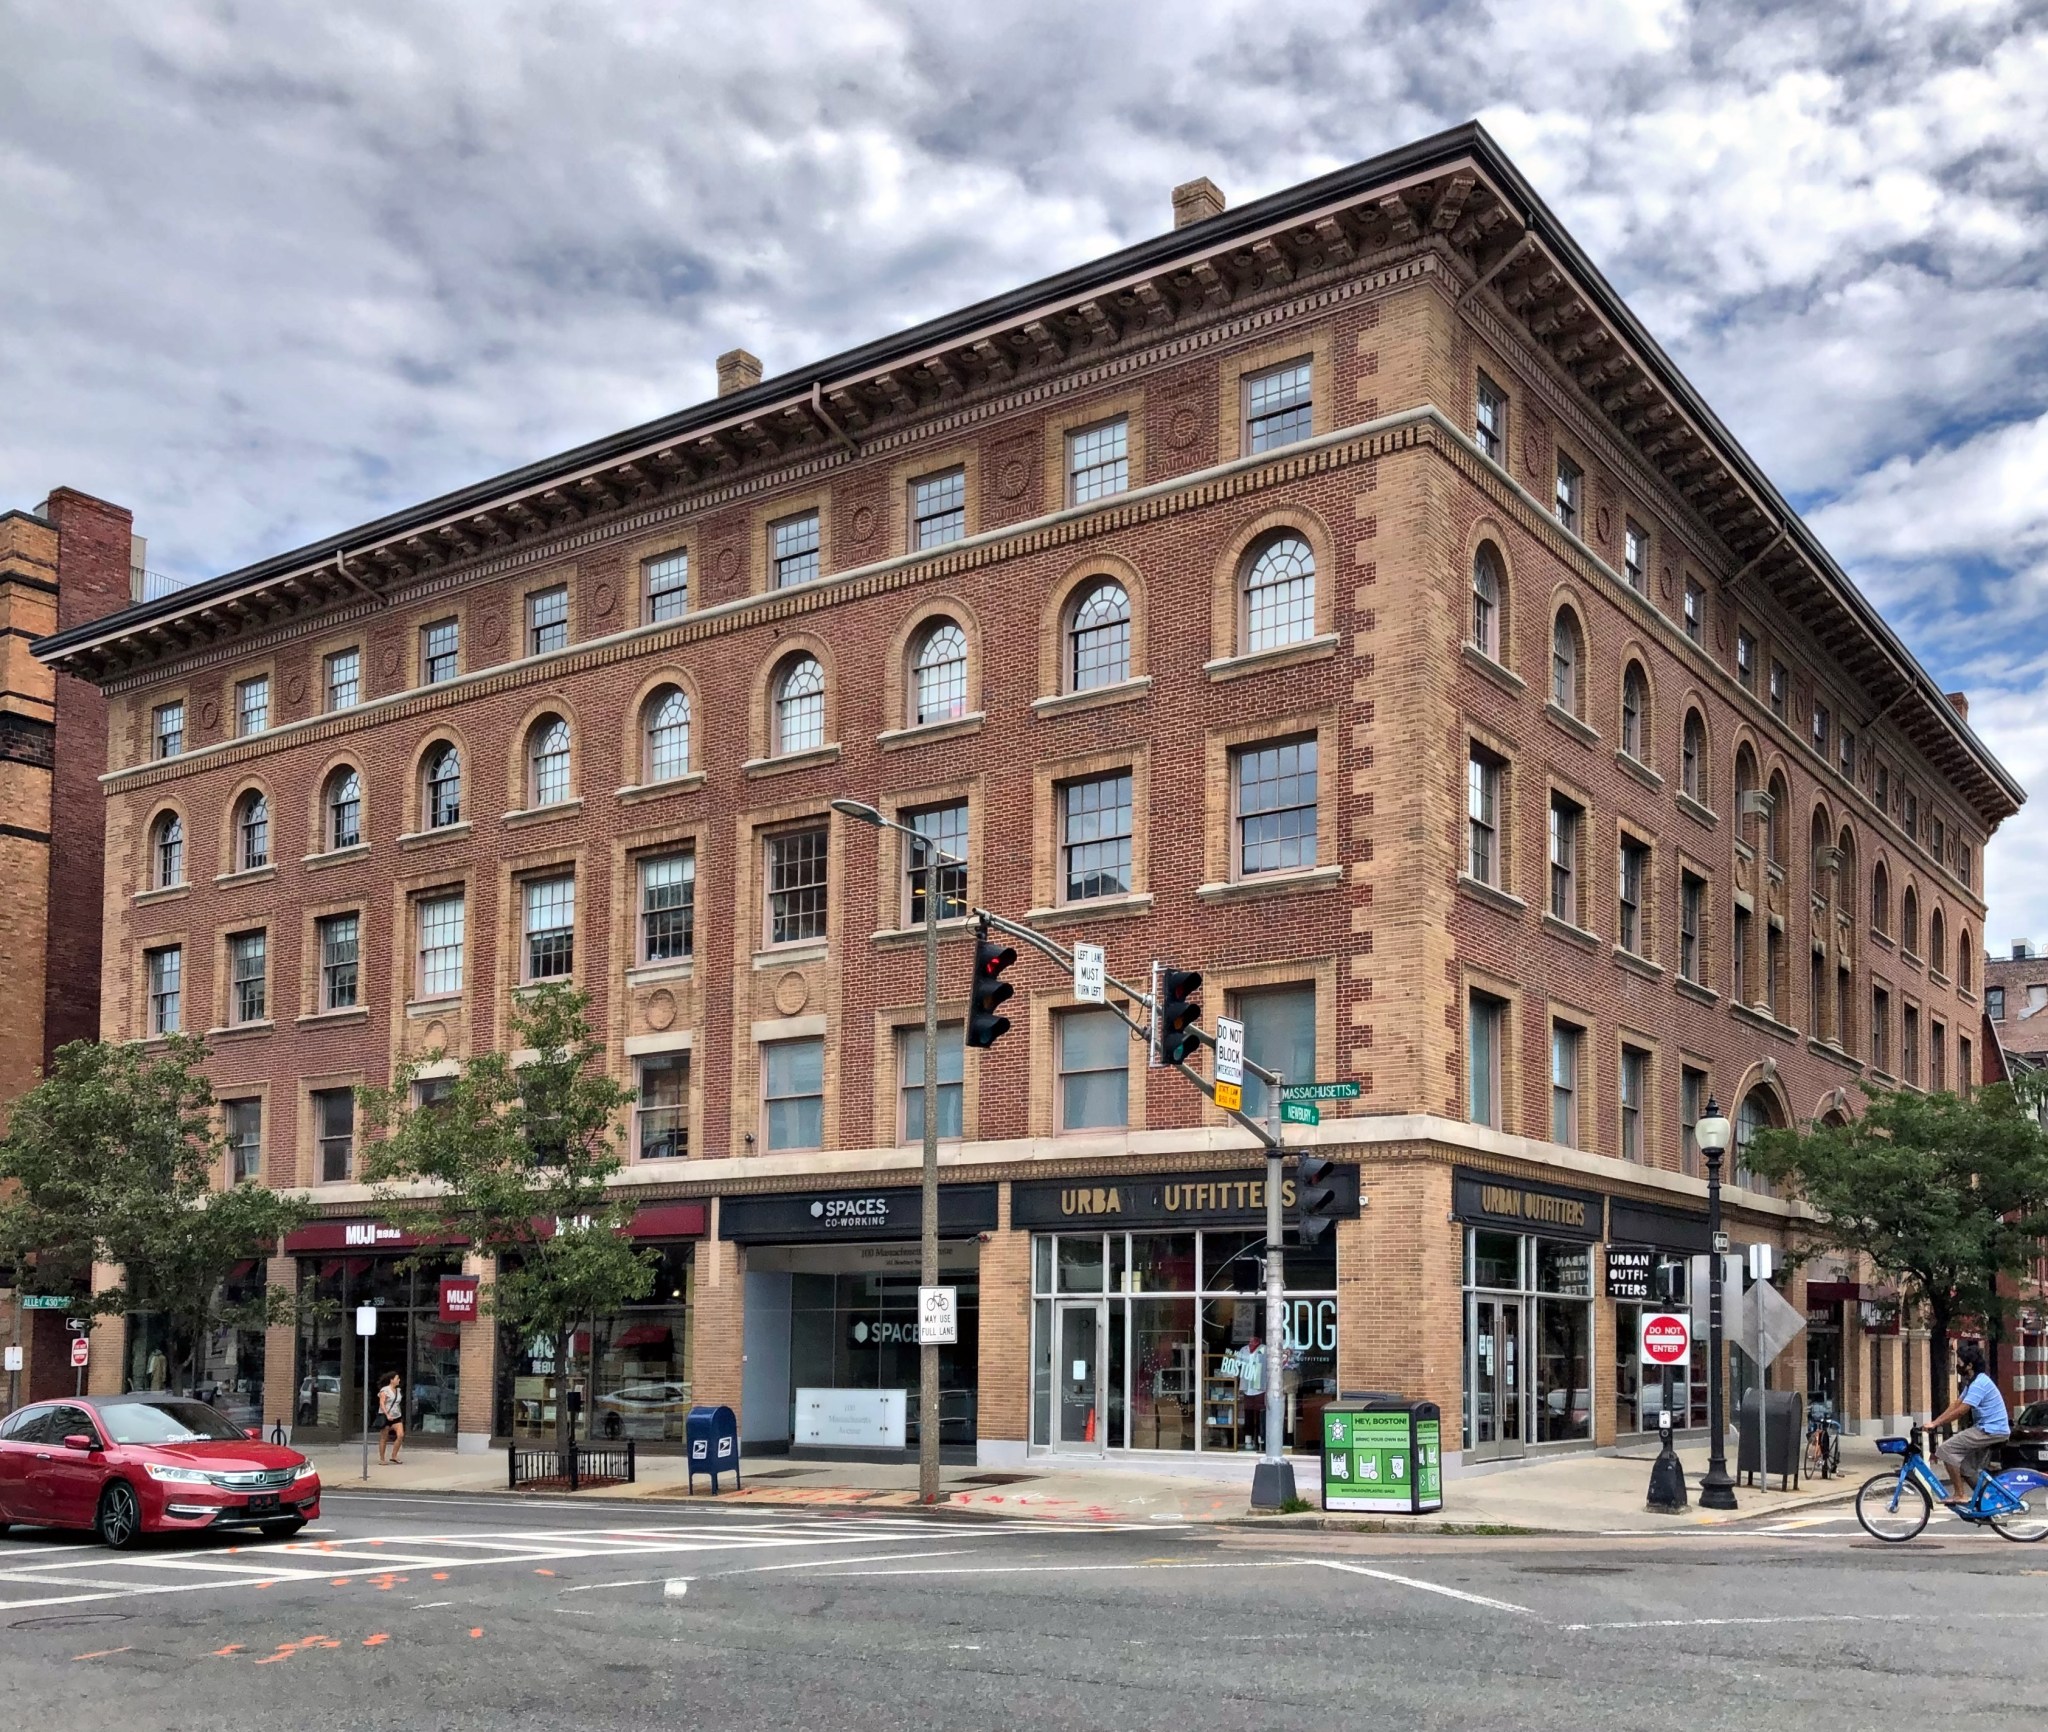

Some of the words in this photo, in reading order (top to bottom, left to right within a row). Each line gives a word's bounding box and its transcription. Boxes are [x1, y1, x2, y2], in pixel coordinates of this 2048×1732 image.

[1077, 950, 1088, 961] LEFT
[1091, 952, 1102, 963] LANE
[1081, 966, 1098, 980] MUST
[1078, 984, 1089, 995] TURN
[1091, 986, 1101, 997] LEFT
[1218, 1025, 1227, 1039] DO
[1230, 1028, 1242, 1044] NOT
[1219, 1046, 1240, 1064] BLOCK
[1282, 1084, 1351, 1100] MASSACHUSETTS
[1287, 1105, 1312, 1122] NEWBURY
[1164, 1180, 1296, 1211] UTFITTES
[1482, 1185, 1520, 1216] URBAN
[1524, 1192, 1585, 1227] OUTFITTERS
[825, 1216, 885, 1228] CO-WORKING
[346, 1225, 376, 1245] MUJI
[1610, 1254, 1649, 1266] URBAN
[1609, 1269, 1648, 1280] OUTFI-
[1609, 1284, 1647, 1295] -TTERS
[23, 1298, 43, 1307] ALLEY
[45, 1298, 58, 1307] 430
[446, 1290, 473, 1304] MUJI
[924, 1314, 937, 1323] MAY
[939, 1314, 951, 1323] USE
[922, 1327, 936, 1336] FULL
[939, 1327, 954, 1336] LANE
[1649, 1326, 1661, 1334] DO
[1665, 1326, 1681, 1334] NOT
[1653, 1345, 1678, 1353] ENTER
[1221, 1357, 1257, 1381] BOSTON
